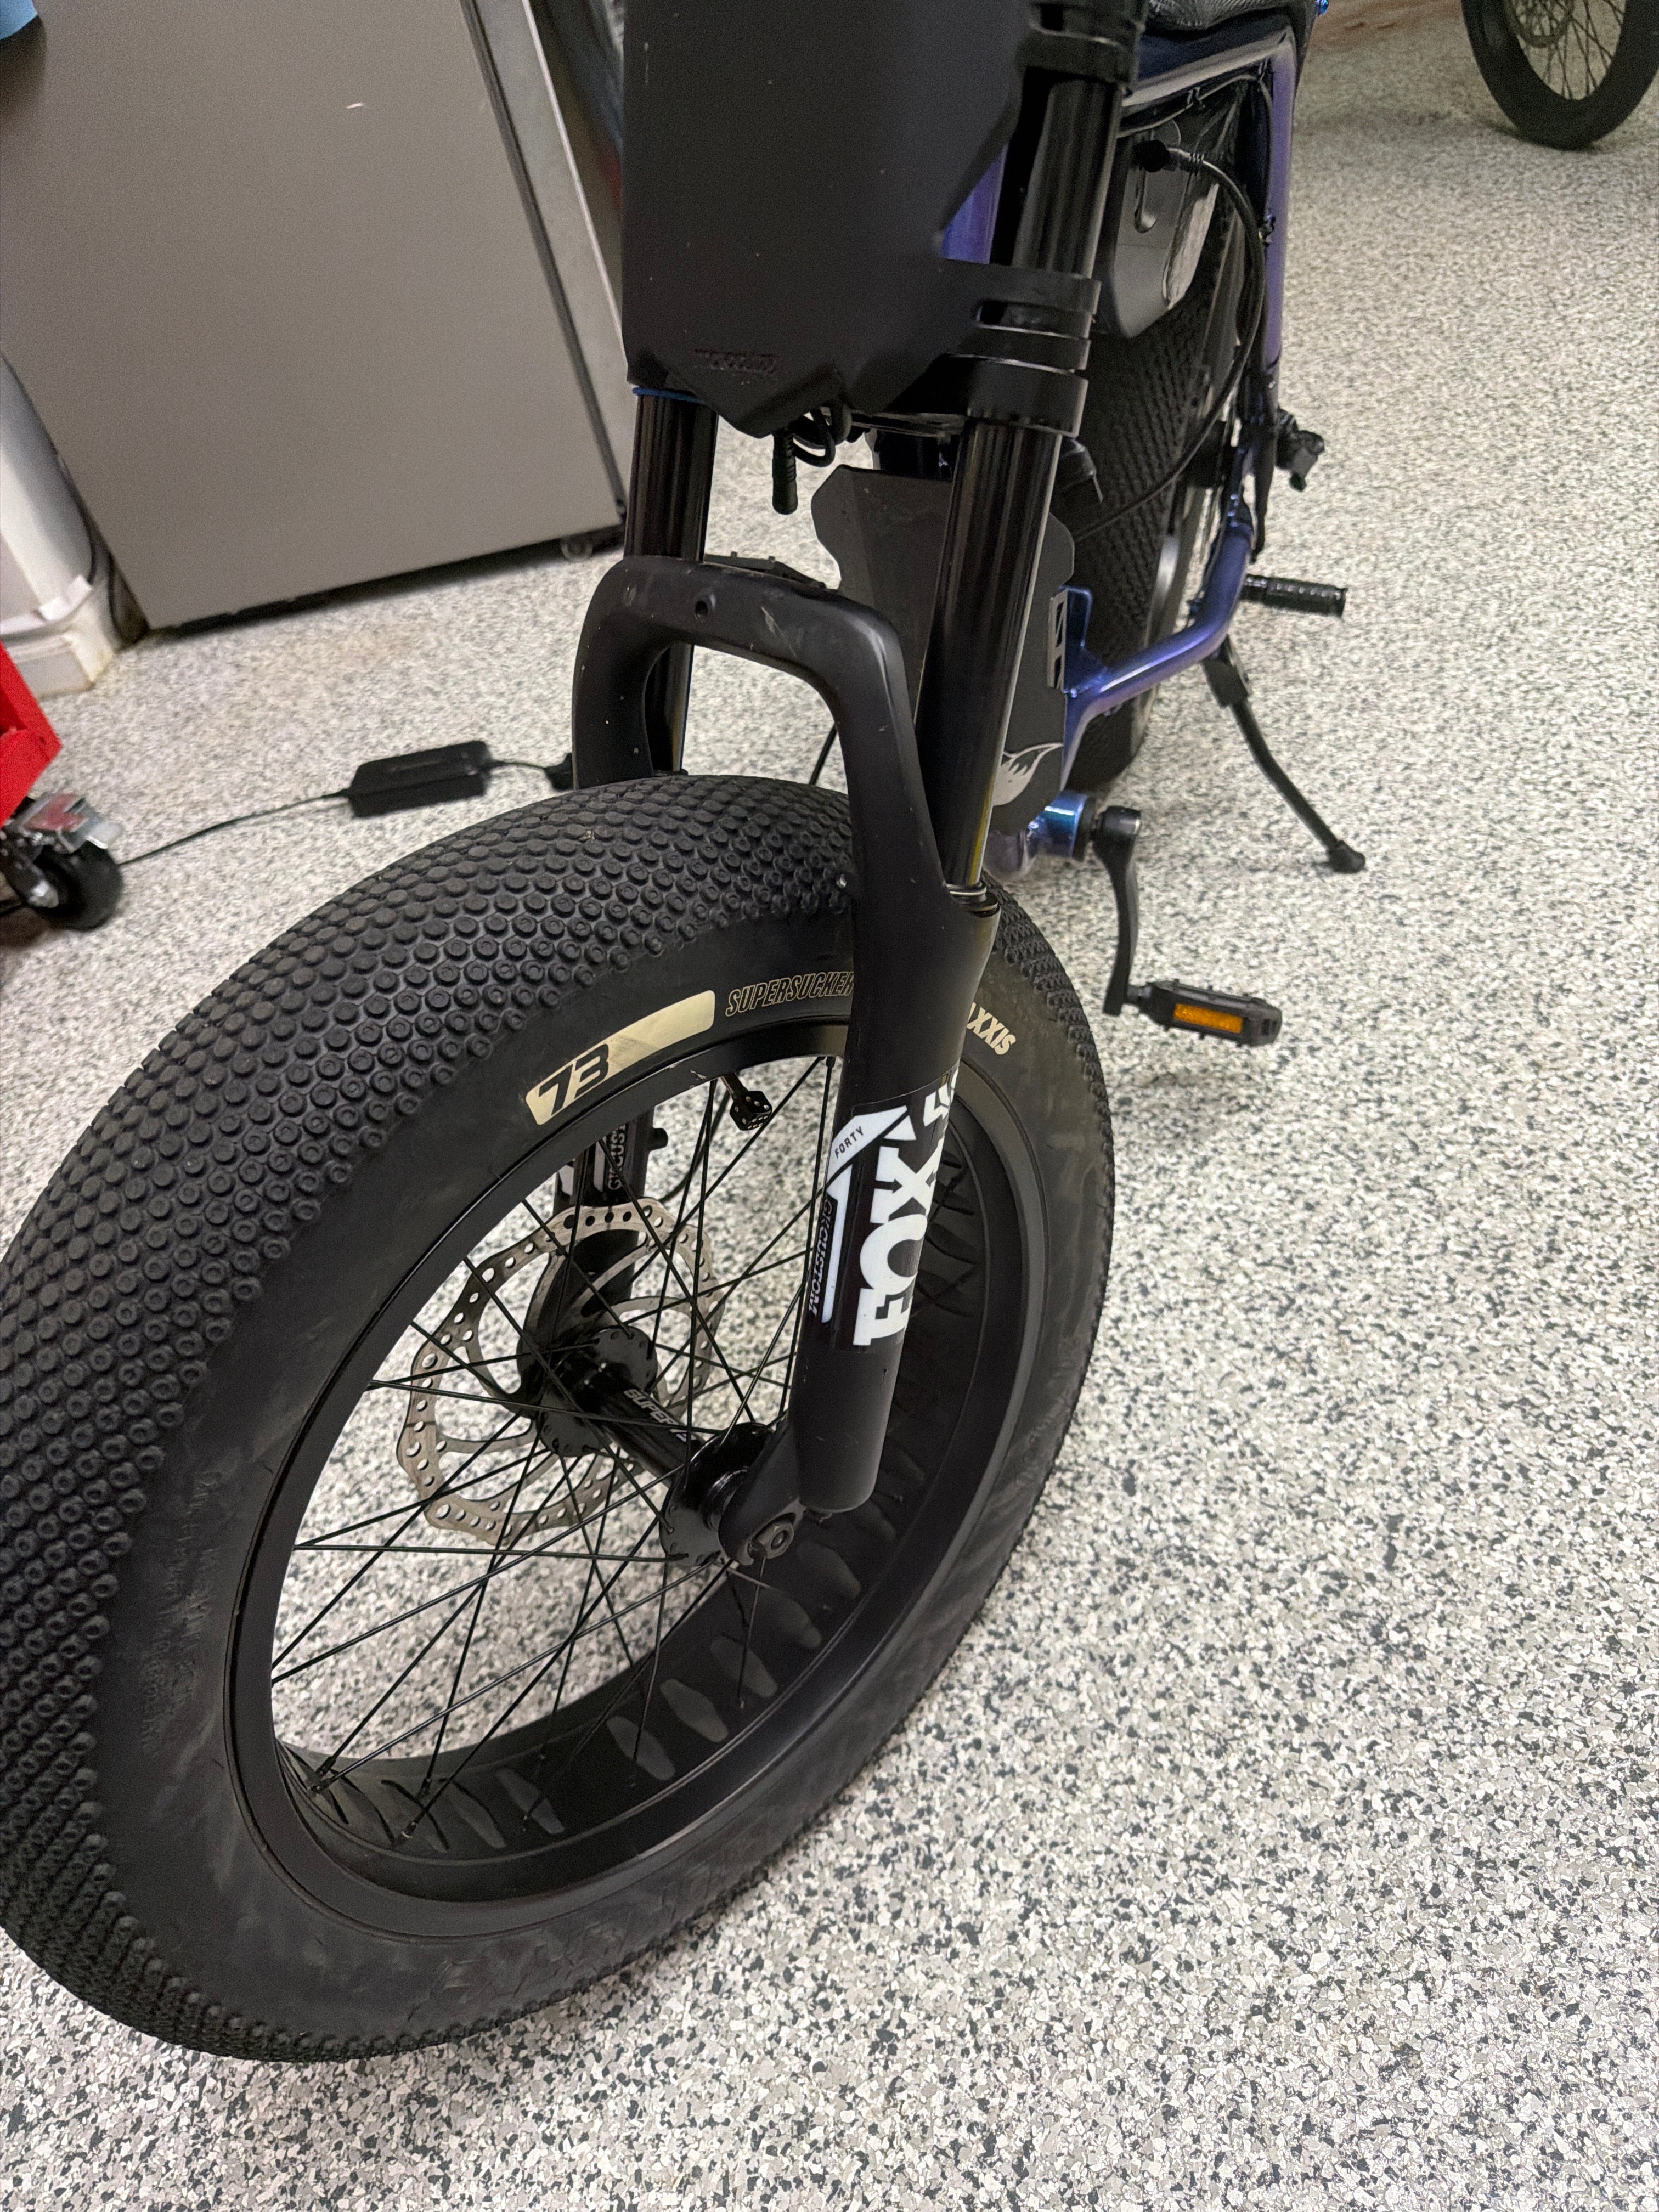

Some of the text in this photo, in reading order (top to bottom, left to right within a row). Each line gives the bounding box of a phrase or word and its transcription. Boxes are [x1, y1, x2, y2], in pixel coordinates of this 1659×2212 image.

[725, 970, 855, 1017] SUPERSUCKER
[538, 1043, 610, 1116] 73
[834, 1125, 865, 1159] FORTY
